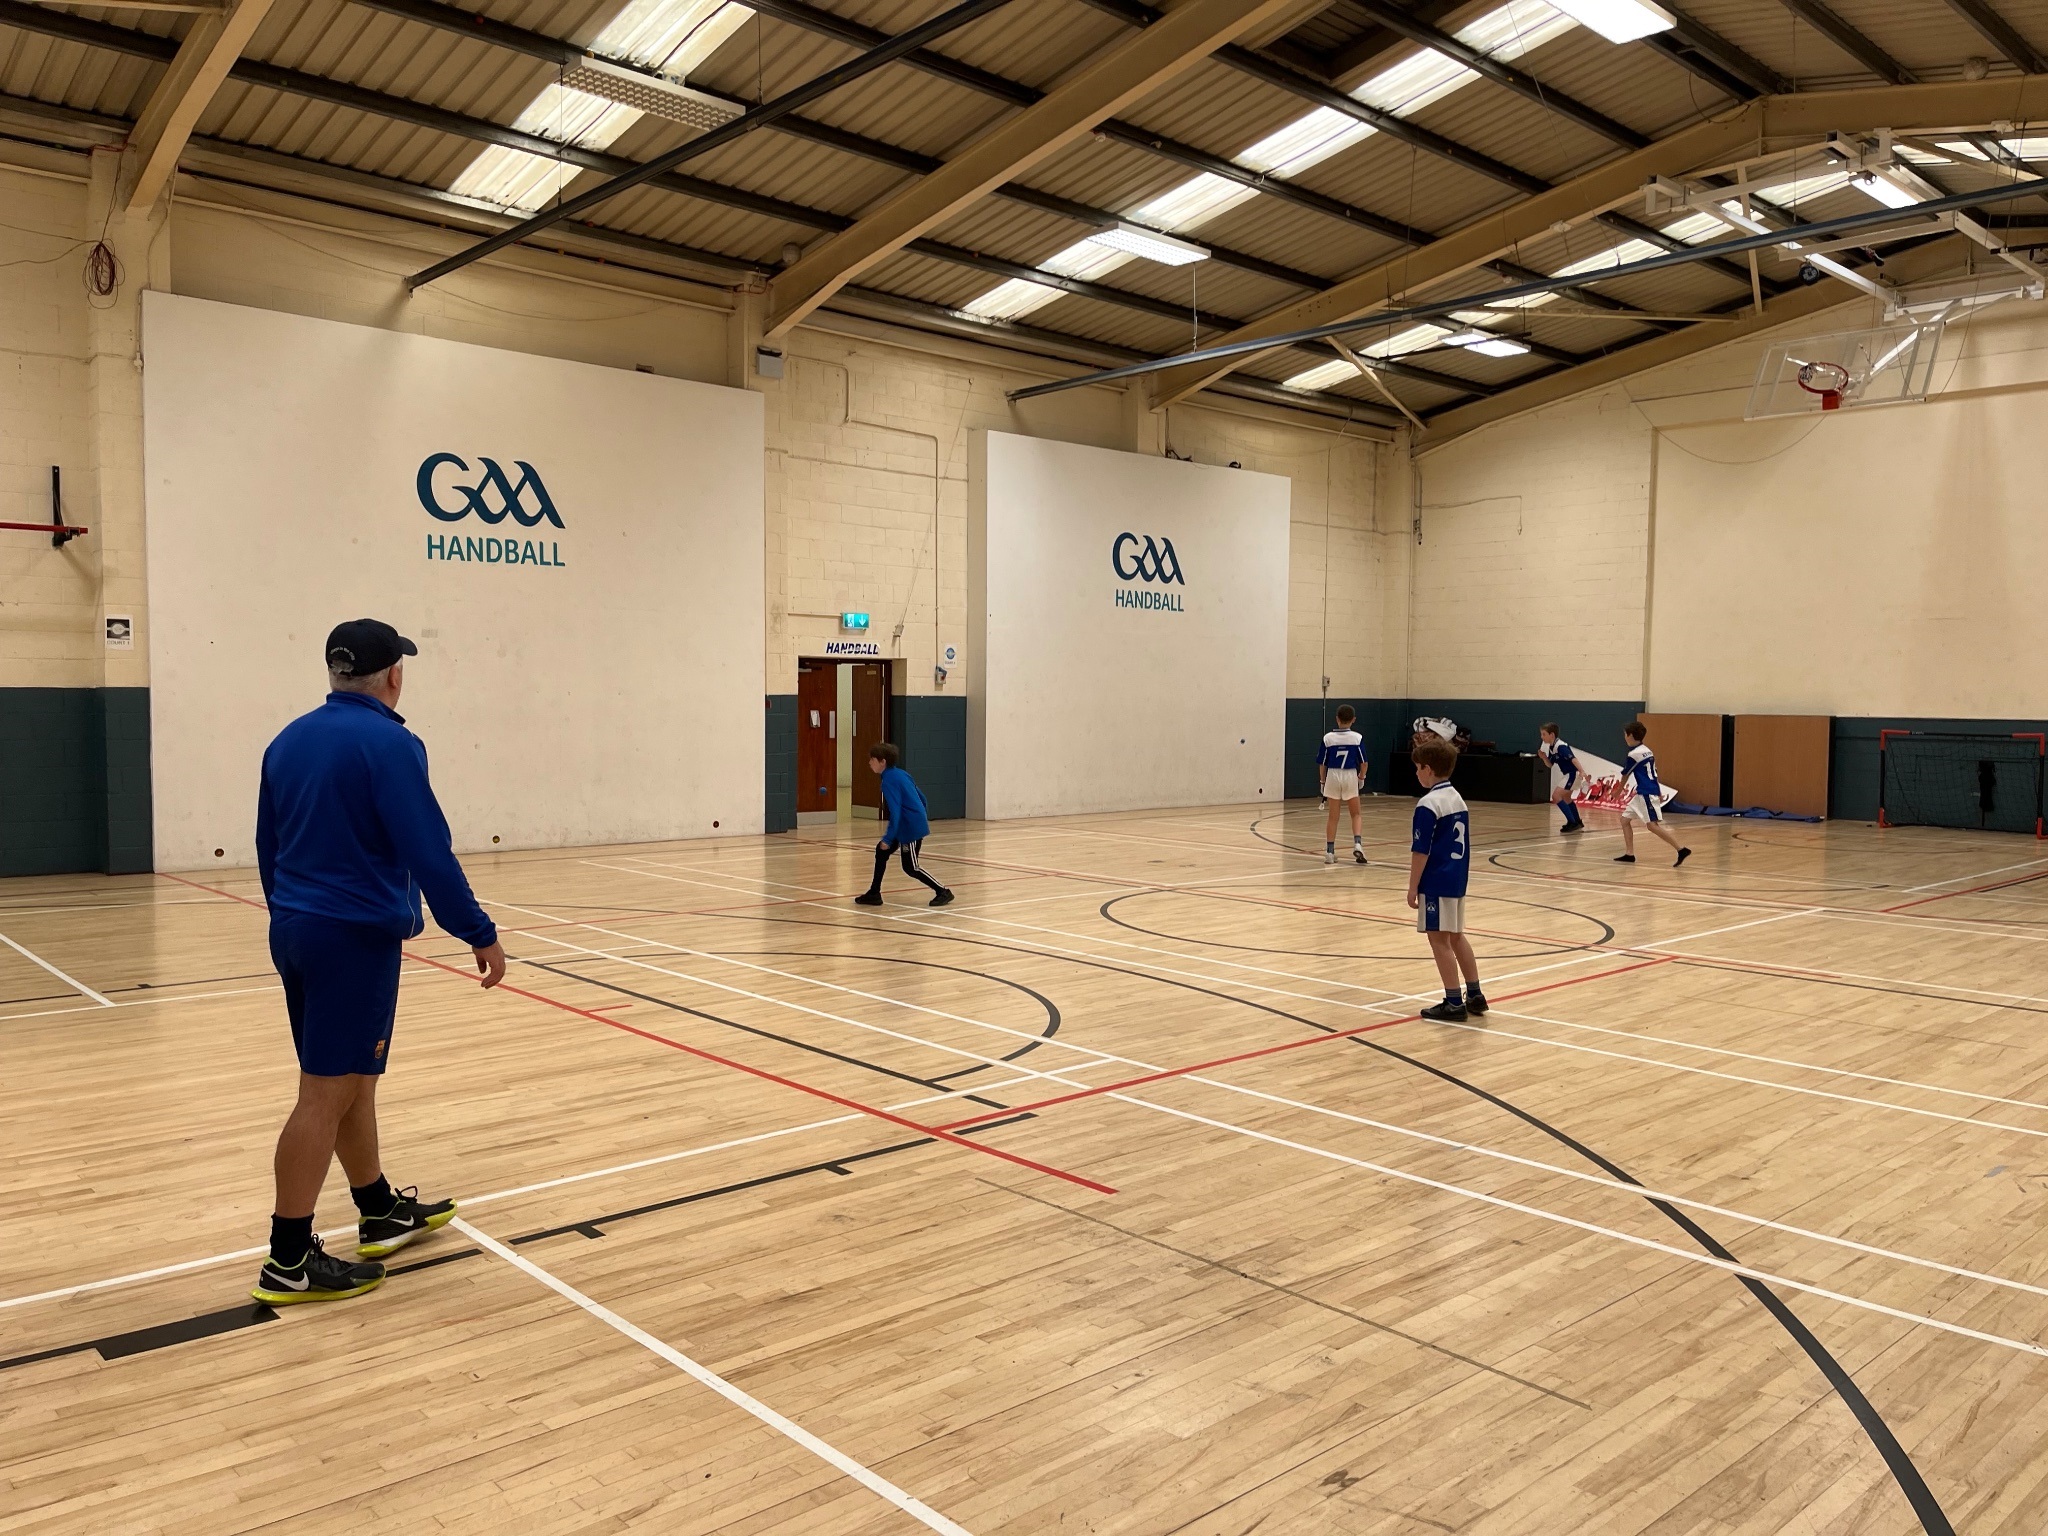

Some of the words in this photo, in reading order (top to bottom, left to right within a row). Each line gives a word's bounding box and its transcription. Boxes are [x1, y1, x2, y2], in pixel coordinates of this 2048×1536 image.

[416, 452, 566, 529] GAA
[427, 534, 566, 567] HANDBALL
[1112, 532, 1186, 586] GAA
[1115, 588, 1185, 612] HANDBALL
[826, 642, 879, 655] HANDBALL
[1335, 750, 1349, 769] 7
[1450, 820, 1466, 860] 3
